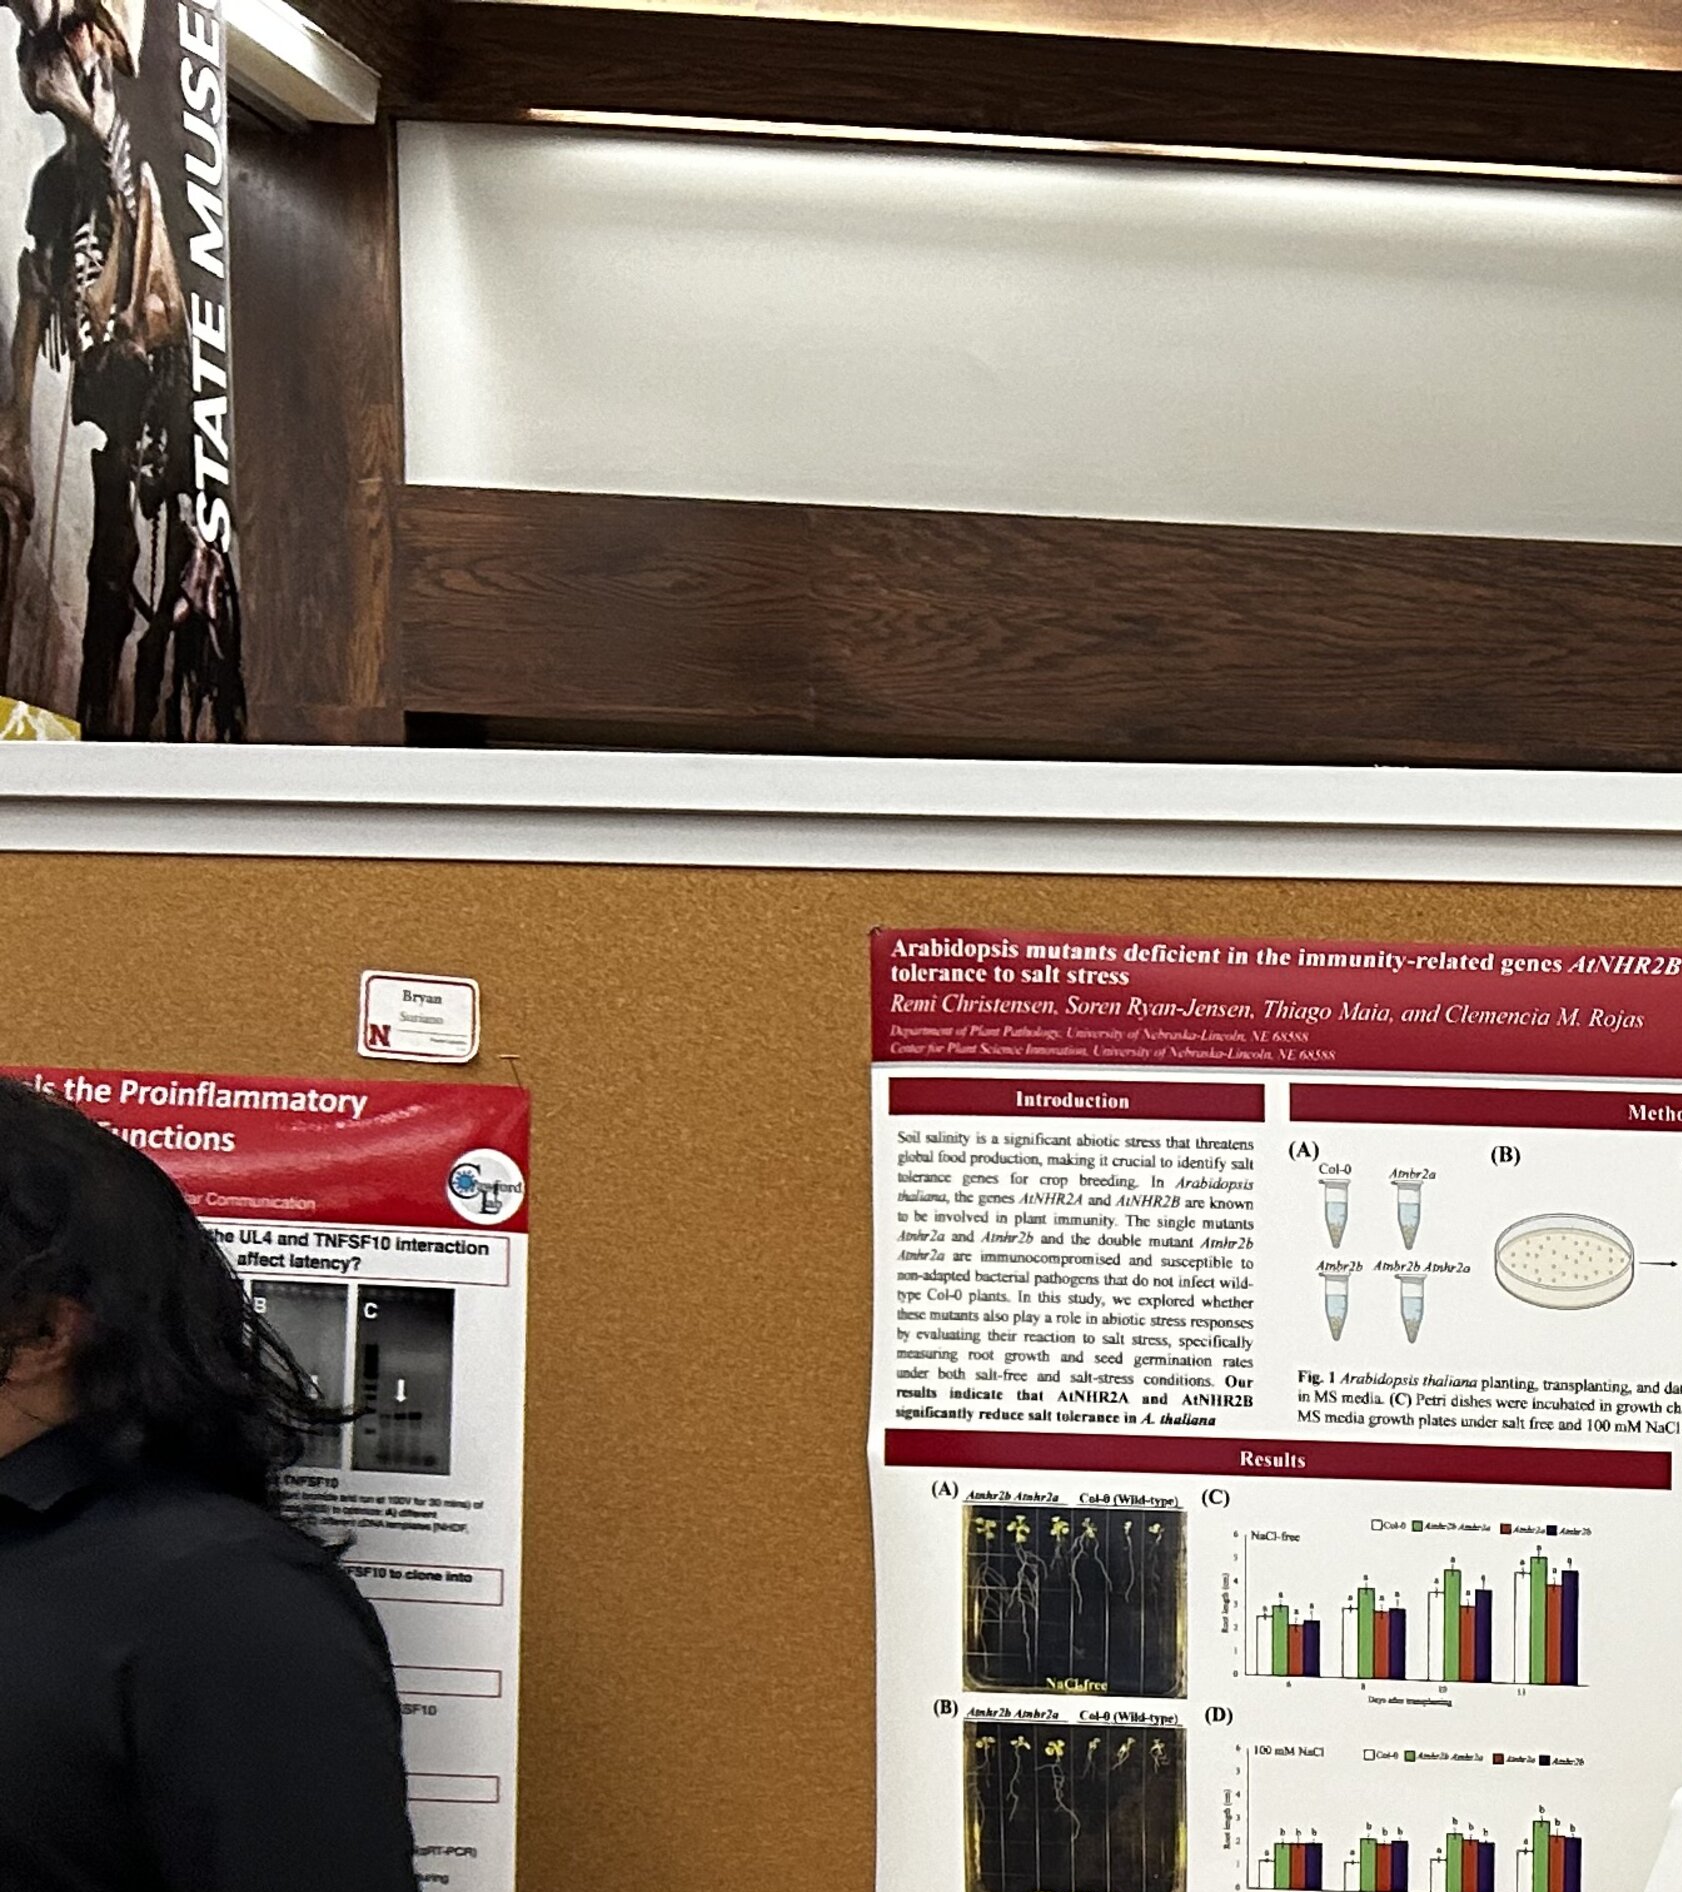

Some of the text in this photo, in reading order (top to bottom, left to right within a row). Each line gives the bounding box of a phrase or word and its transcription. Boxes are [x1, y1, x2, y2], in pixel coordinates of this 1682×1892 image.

[178, 0, 231, 552] STATE MUSE
[891, 937, 1018, 962] Arabidopsis
[1026, 943, 1116, 961] mutants
[1123, 943, 1220, 963] deficient
[1227, 946, 1247, 964] in
[1257, 947, 1290, 965] the
[1298, 948, 1494, 973] immunity-related
[1500, 958, 1561, 975] genes
[1567, 955, 1681, 975] AtNHR2B
[891, 964, 1128, 984] tolerance to salt stress
[402, 990, 442, 1006] Bryan
[890, 993, 1643, 1032] Remi Christensen, Soren Ryan-Jensen, Thiago Maia, and Clemencia M. Rojas
[369, 1024, 391, 1047] N
[64, 1076, 111, 1102] the
[120, 1080, 367, 1120] Proinflammatory
[1016, 1090, 1128, 1108] Introduction
[97, 1121, 236, 1152] unctions
[1288, 1141, 1319, 1161] (A)
[1491, 1145, 1520, 1166] (B)
[239, 1229, 272, 1245] UL4
[277, 1231, 308, 1247] and
[395, 1236, 489, 1256] interaction
[237, 1253, 360, 1274] affect latency?
[363, 1302, 378, 1319] C
[896, 1386, 936, 1397] results
[949, 1388, 1002, 1399] indicate
[1016, 1389, 1042, 1401] that
[1142, 1392, 1167, 1404] and
[1240, 1451, 1305, 1467] Results
